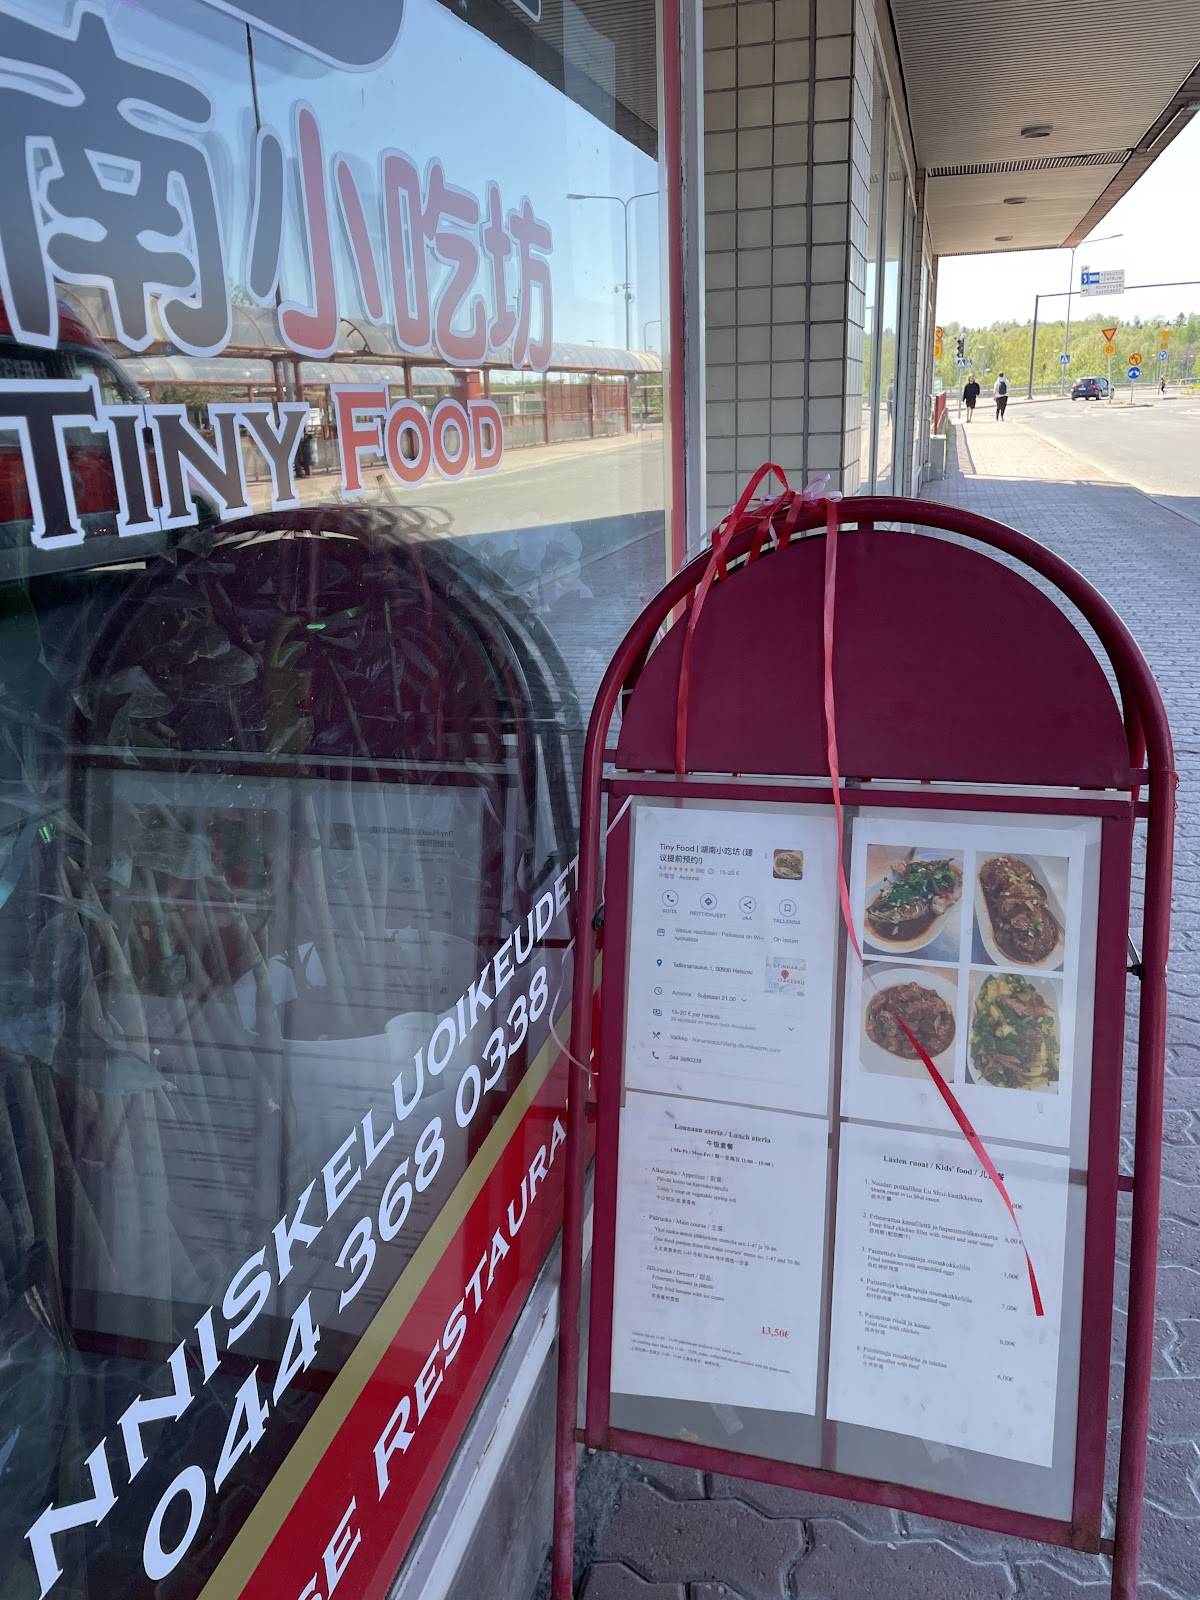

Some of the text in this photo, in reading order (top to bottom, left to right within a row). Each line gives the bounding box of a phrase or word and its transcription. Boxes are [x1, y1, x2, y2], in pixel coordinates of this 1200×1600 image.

[0, 375, 504, 549] TINY FOOD
[660, 843, 674, 852] Tiny
[676, 844, 695, 852] Food
[729, 1131, 750, 1141] Lunch
[956, 1165, 973, 1177] food
[143, 965, 550, 1581] 044 368 0338
[373, 1098, 570, 1502] RESTAURA
[761, 1325, 790, 1339] 13,50€
